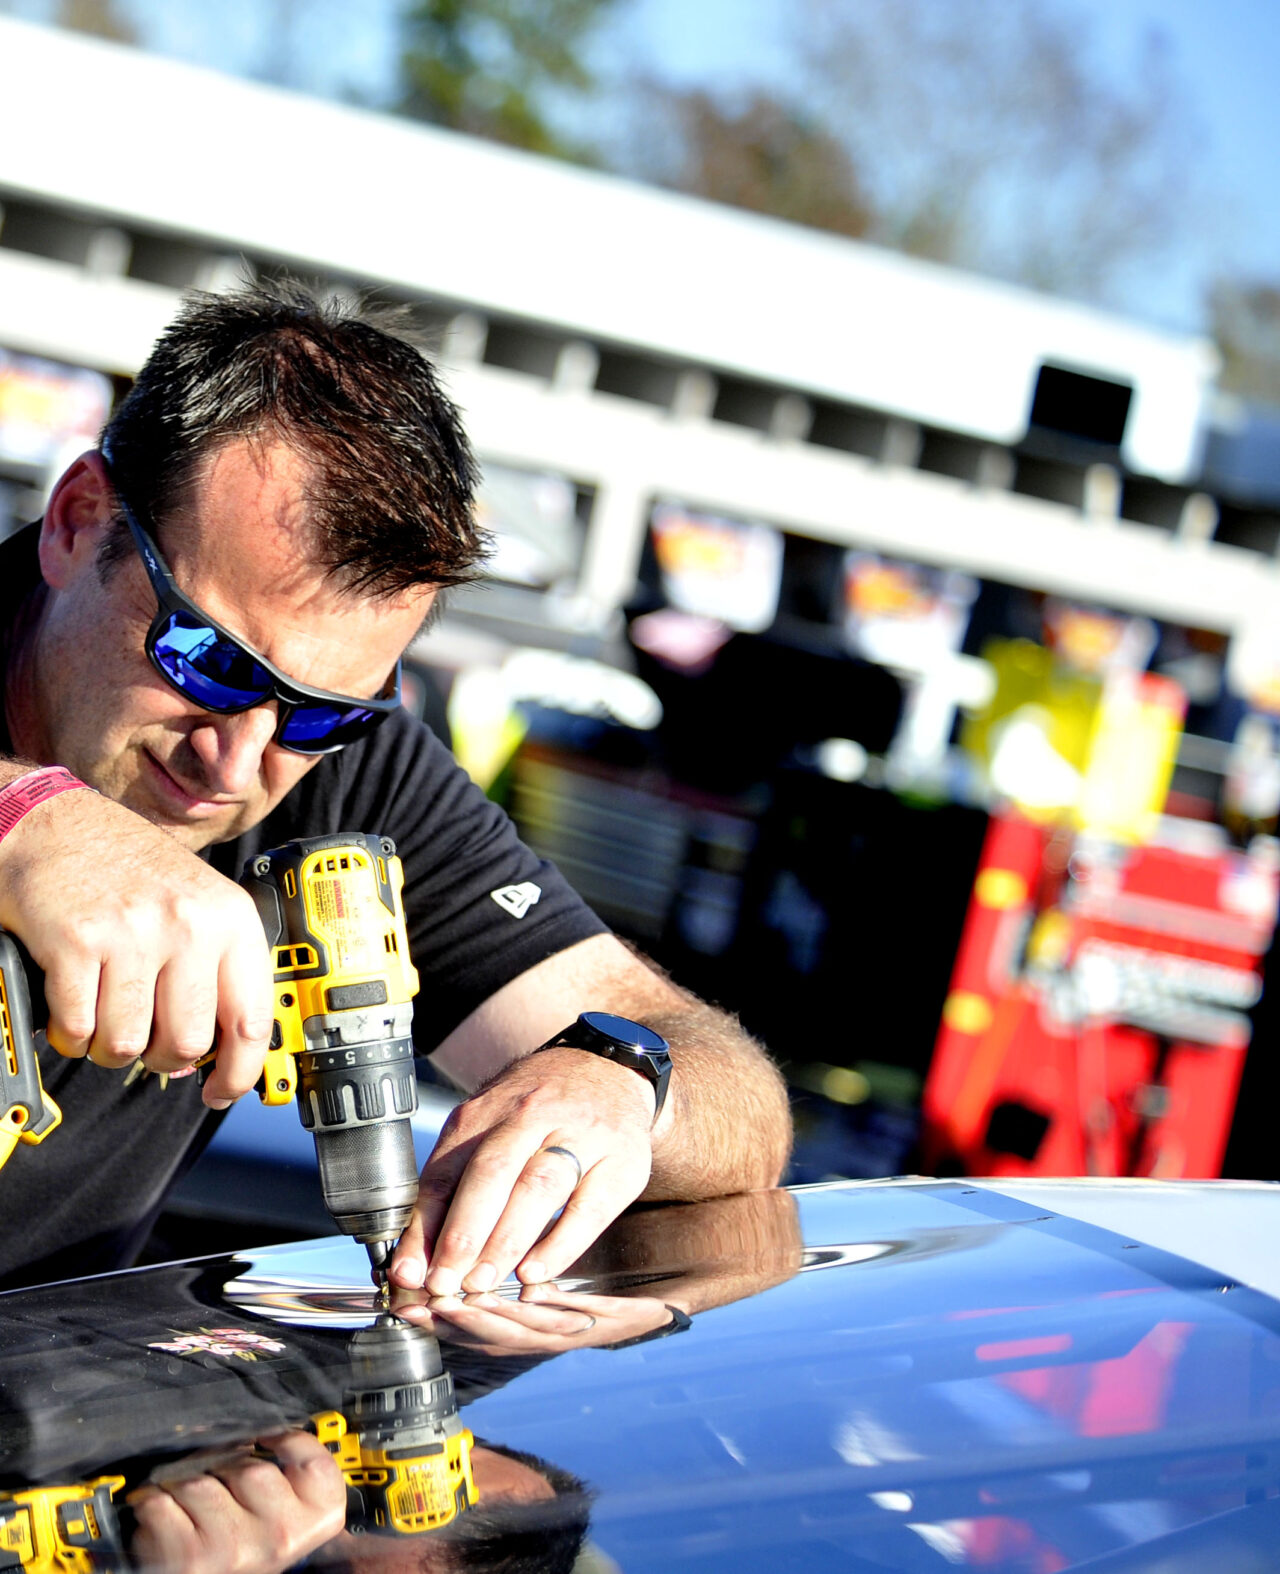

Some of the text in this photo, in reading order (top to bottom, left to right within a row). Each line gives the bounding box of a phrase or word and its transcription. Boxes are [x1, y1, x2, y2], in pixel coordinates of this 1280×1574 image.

[345, 1052, 356, 1065] 5
[383, 1047, 392, 1059] 3
[311, 1057, 319, 1070] 7
